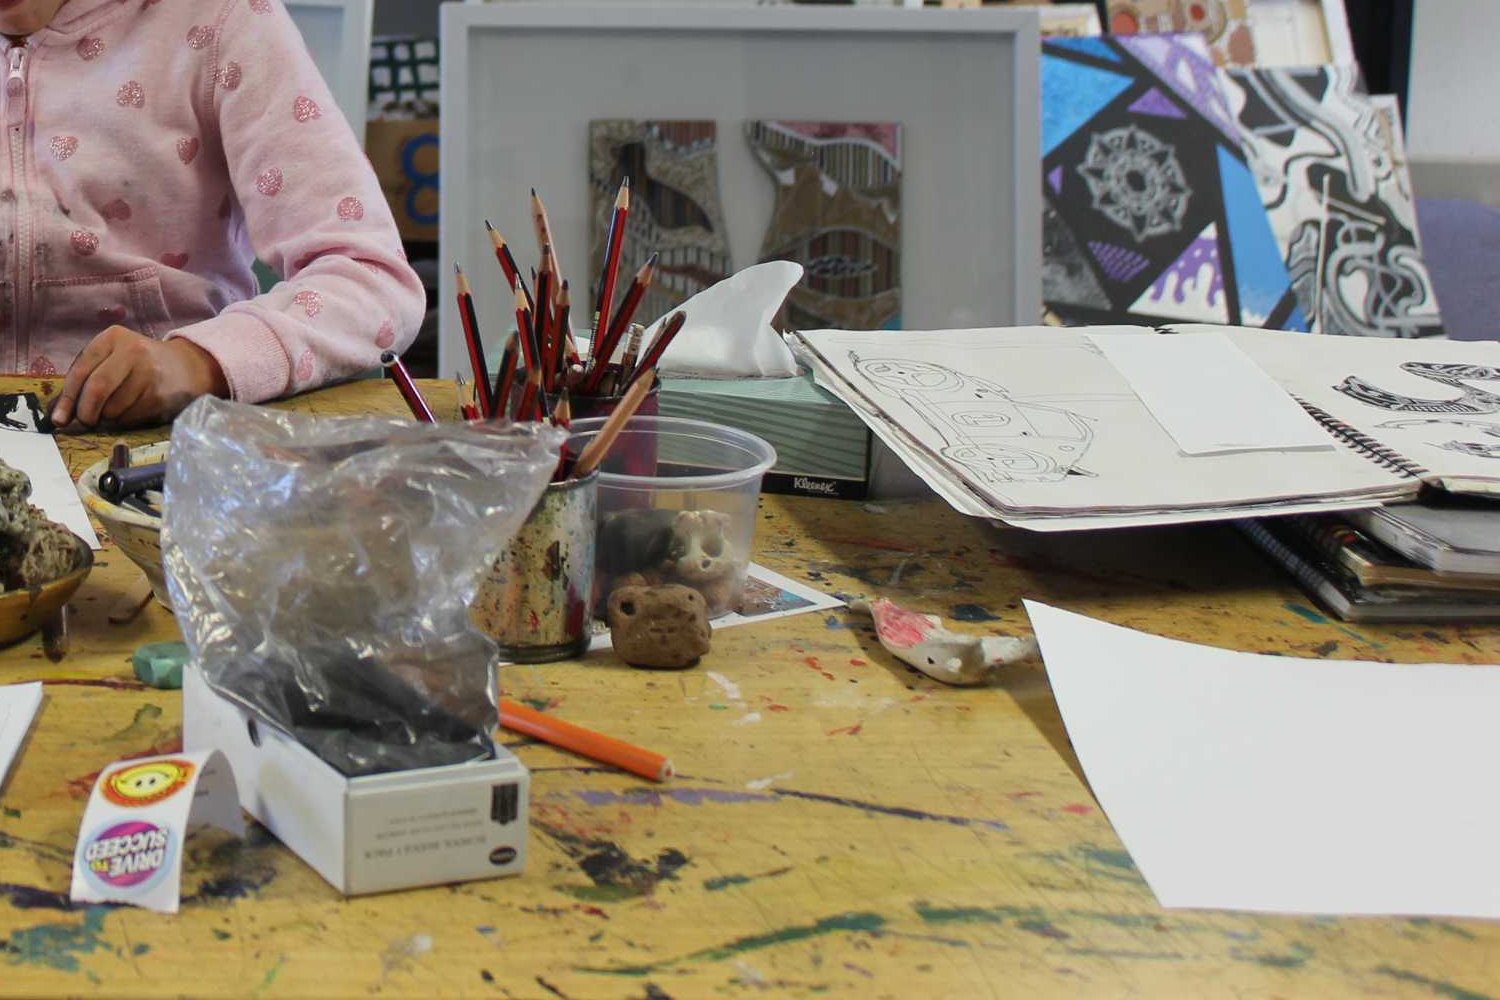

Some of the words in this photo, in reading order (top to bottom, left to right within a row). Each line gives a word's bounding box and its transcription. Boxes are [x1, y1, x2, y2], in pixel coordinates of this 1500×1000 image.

[794, 476, 837, 494] Kleenex
[84, 826, 169, 862] SUCCEED
[108, 849, 165, 878] DRIVE
